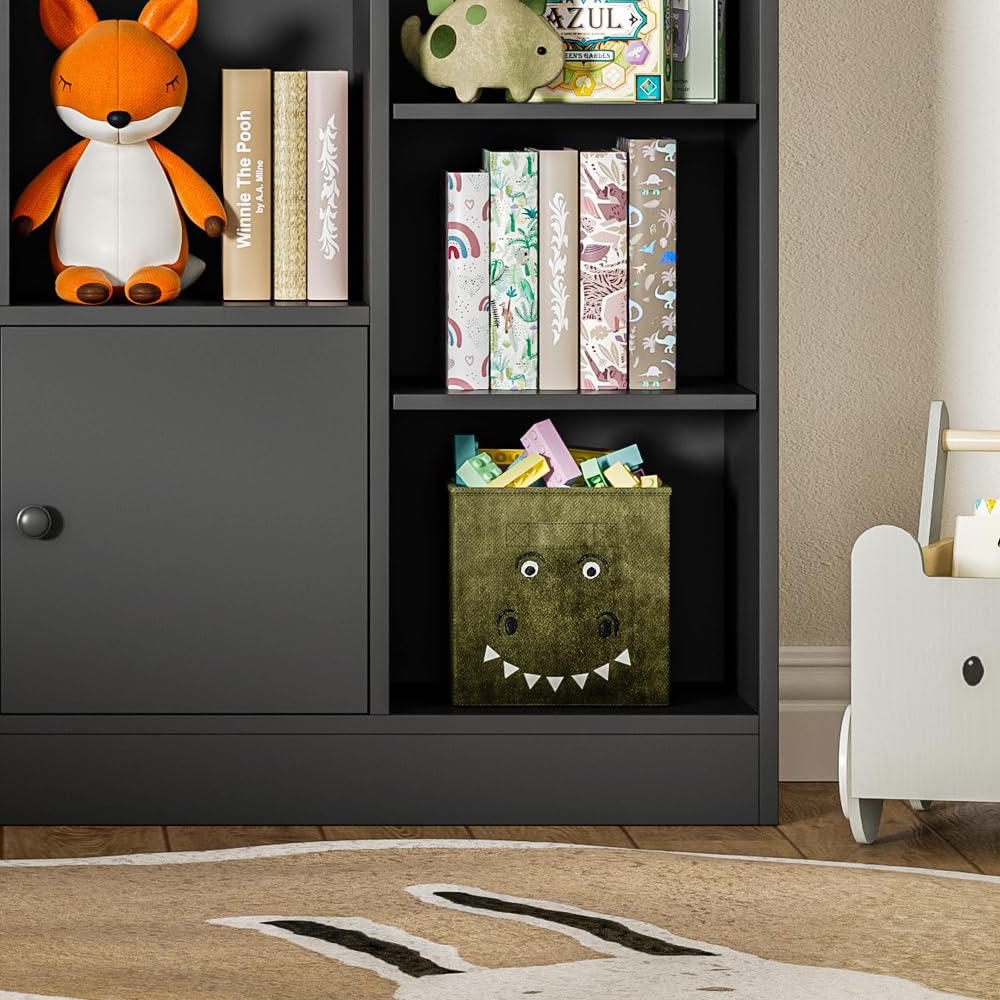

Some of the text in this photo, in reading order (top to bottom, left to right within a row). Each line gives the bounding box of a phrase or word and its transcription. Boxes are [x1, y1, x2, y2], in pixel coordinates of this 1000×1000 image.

[547, 7, 622, 30] AZUL
[565, 52, 583, 60] EEN'S
[236, 110, 251, 249] Winnie The Pooh
[256, 160, 265, 214] by A.A. Milne
